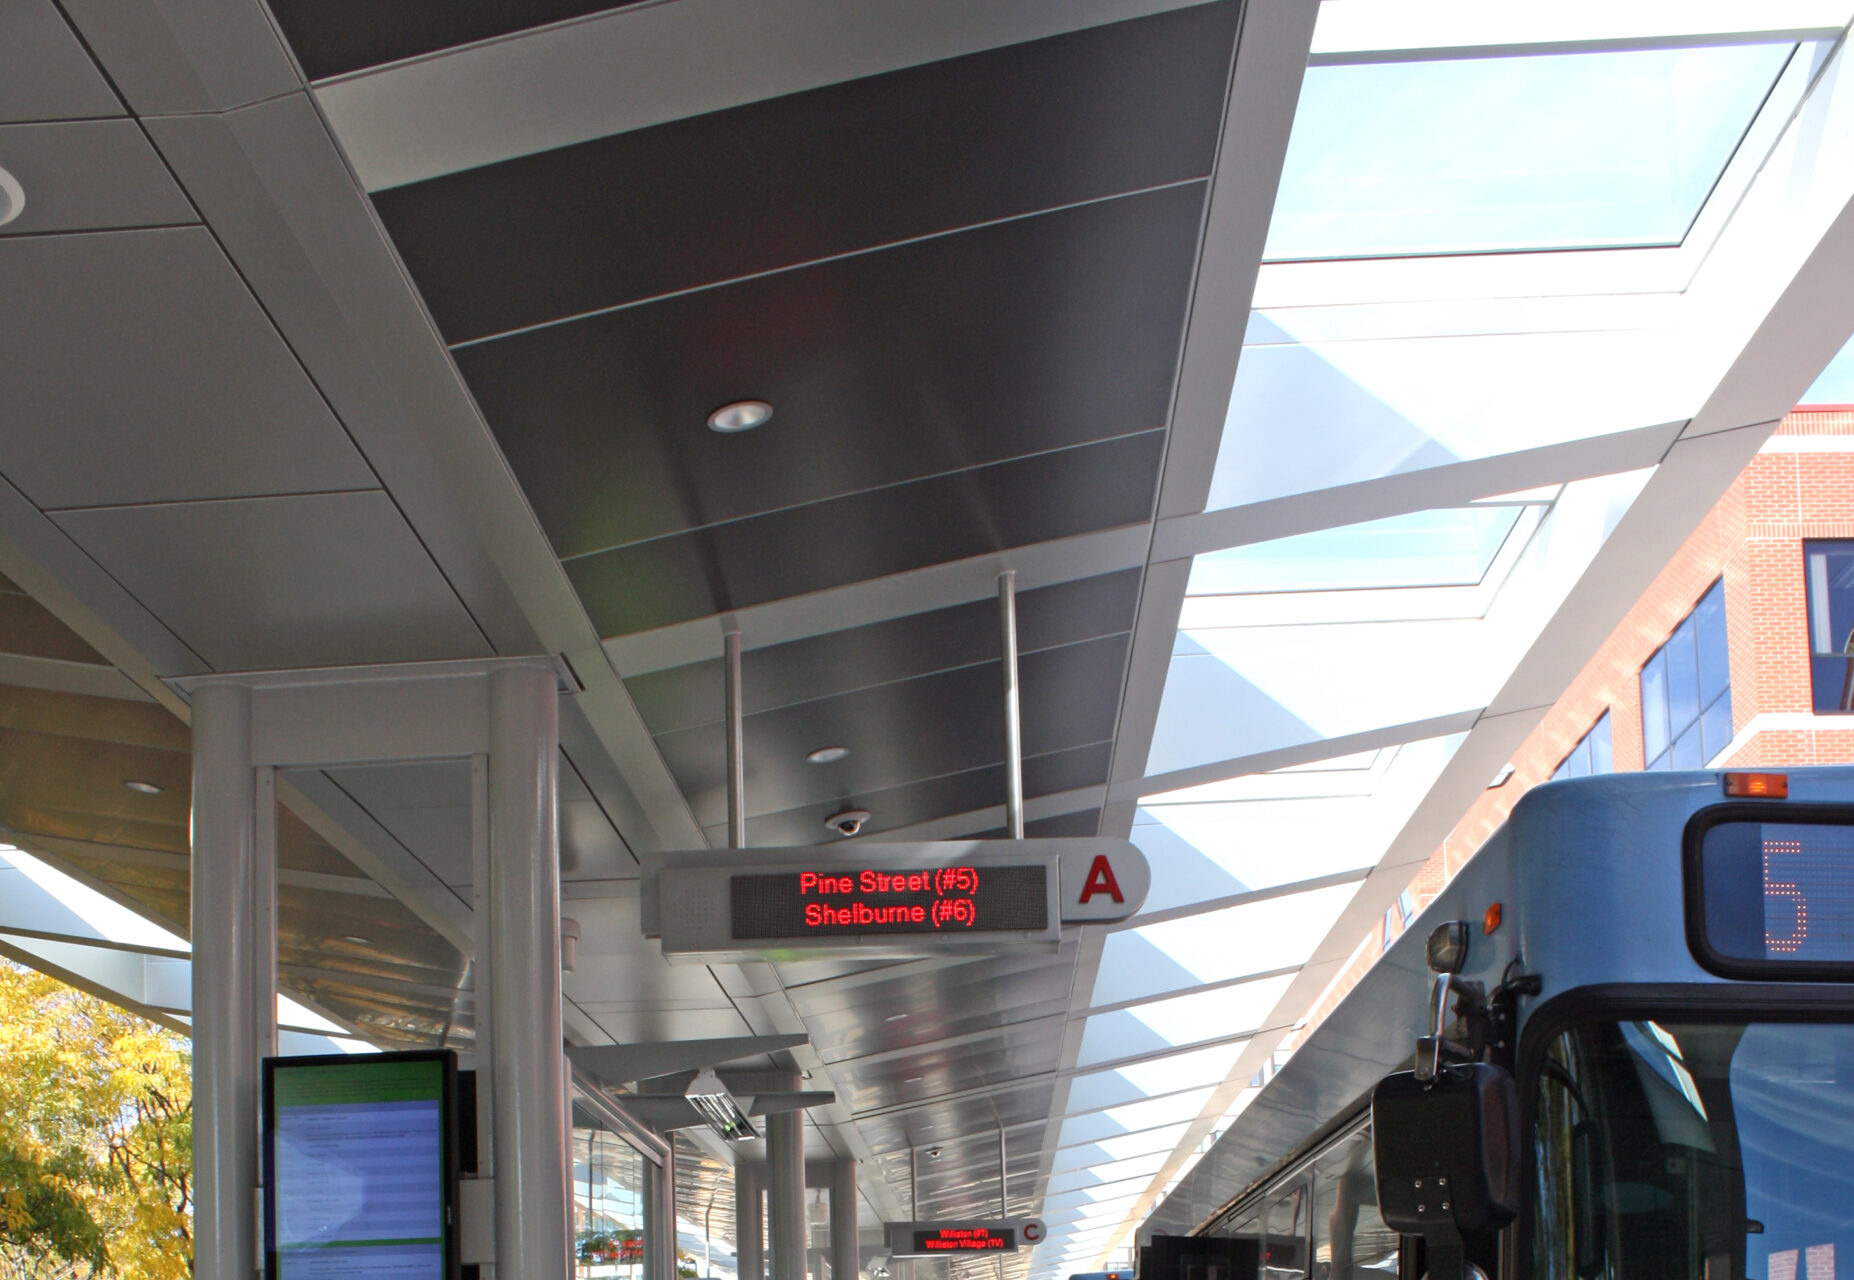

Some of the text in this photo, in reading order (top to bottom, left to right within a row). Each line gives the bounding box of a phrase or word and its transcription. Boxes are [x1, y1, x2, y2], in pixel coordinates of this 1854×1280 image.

[800, 867, 979, 895] Pine Street (#5)
[1079, 854, 1124, 904] A
[1763, 839, 1808, 952] 5
[805, 898, 976, 928] Shelburne (#6)
[959, 1238, 986, 1250] Village
[1025, 1224, 1038, 1240] C
